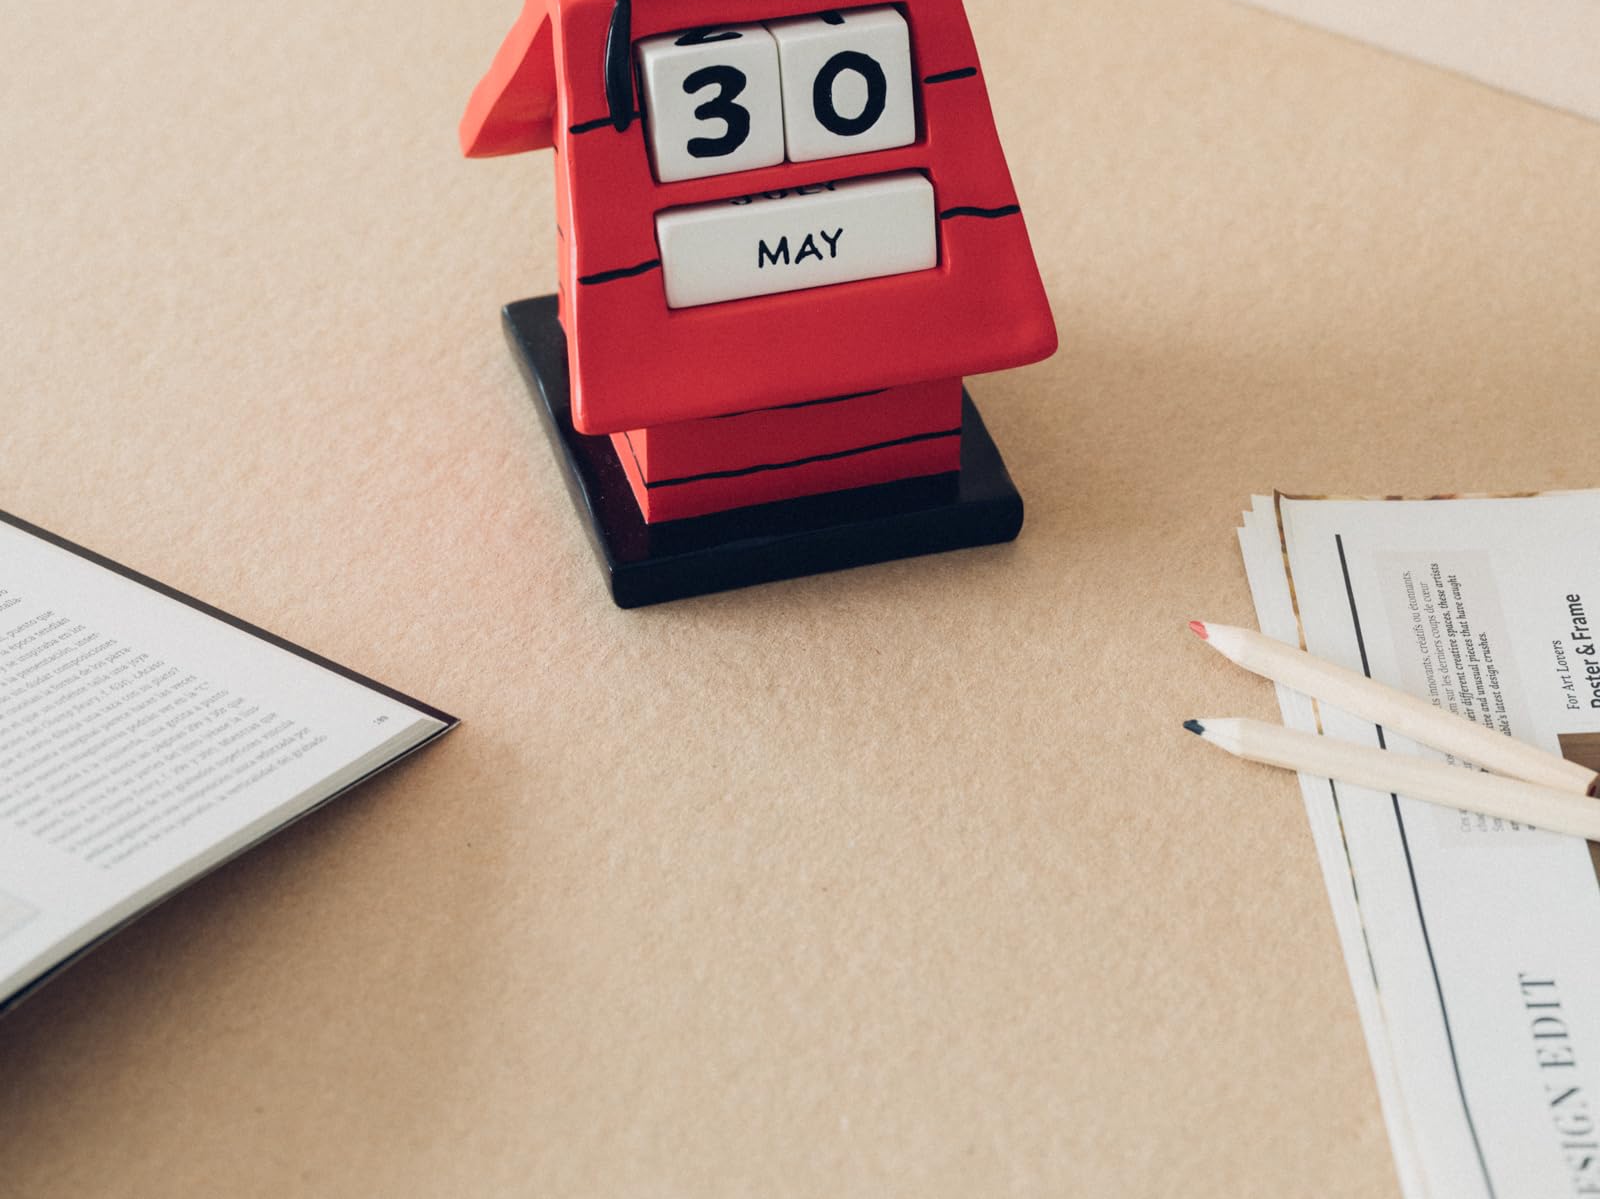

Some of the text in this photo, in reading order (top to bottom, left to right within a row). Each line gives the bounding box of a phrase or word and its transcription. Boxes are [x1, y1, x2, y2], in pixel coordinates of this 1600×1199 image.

[682, 50, 887, 158] 30
[758, 228, 843, 268] MAY
[1430, 563, 1444, 588] artists
[1447, 575, 1462, 600] caught
[1402, 570, 1419, 611] étonnants,
[1419, 582, 1432, 602] cœur
[1437, 589, 1449, 609] these
[1412, 612, 1421, 623] ou
[1423, 603, 1434, 614] de
[1455, 601, 1466, 619] have
[1565, 593, 1591, 640] Frame
[1427, 614, 1441, 638] coups
[1442, 610, 1457, 637] spaces,
[1459, 621, 1471, 637] that
[1412, 624, 1429, 653] créatifs
[1464, 638, 1480, 662] pieces
[1478, 631, 1493, 663] crushes.
[1575, 643, 1595, 656] &
[1433, 639, 1449, 673] derniers
[1448, 638, 1464, 670] creative
[1422, 655, 1439, 697] innovants,
[1441, 674, 1452, 686] les
[1467, 664, 1485, 695] unusual
[1486, 664, 1500, 689] design
[1552, 640, 1580, 710] For Art Lovers
[1445, 687, 1456, 701] sur
[1456, 672, 1474, 706] different
[1476, 697, 1490, 712] and
[1492, 691, 1506, 713] latest
[1518, 973, 1575, 1068] EDIT
